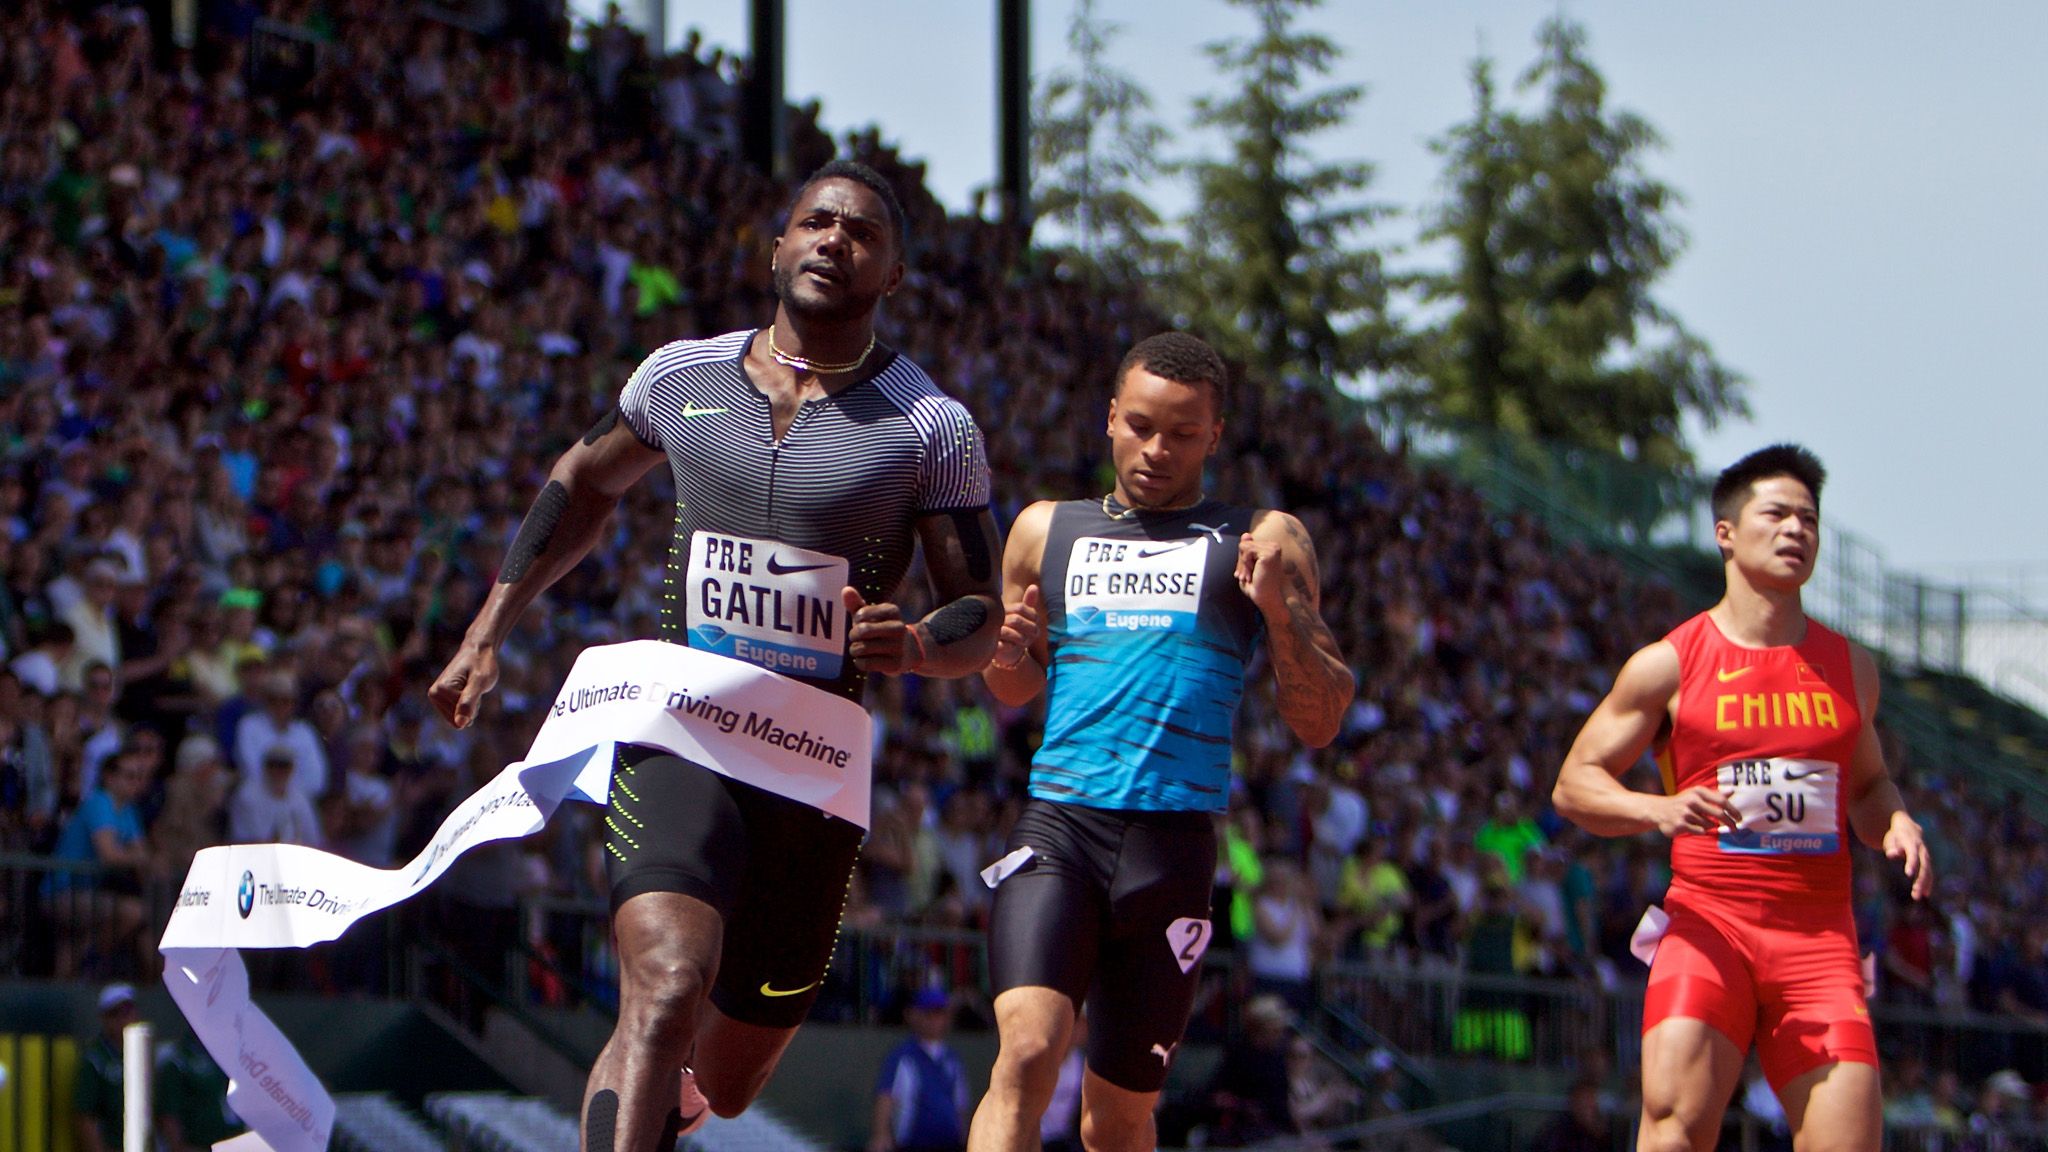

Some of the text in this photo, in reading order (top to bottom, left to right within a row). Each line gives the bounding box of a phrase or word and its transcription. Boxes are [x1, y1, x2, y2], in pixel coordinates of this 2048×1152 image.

[705, 536, 753, 576] PRE
[1085, 541, 1128, 563] PRE
[1070, 572, 1197, 597] DE GRASSE
[702, 577, 834, 640] GATLIN
[1105, 612, 1173, 631] Eugene
[734, 638, 818, 671] Eugene
[569, 681, 642, 713] Ultimate
[1716, 691, 1840, 731] CHINA
[1731, 761, 1772, 787] PRE
[1765, 792, 1806, 823] SU
[1759, 834, 1823, 850] Eugene
[1179, 920, 1203, 961] 2
